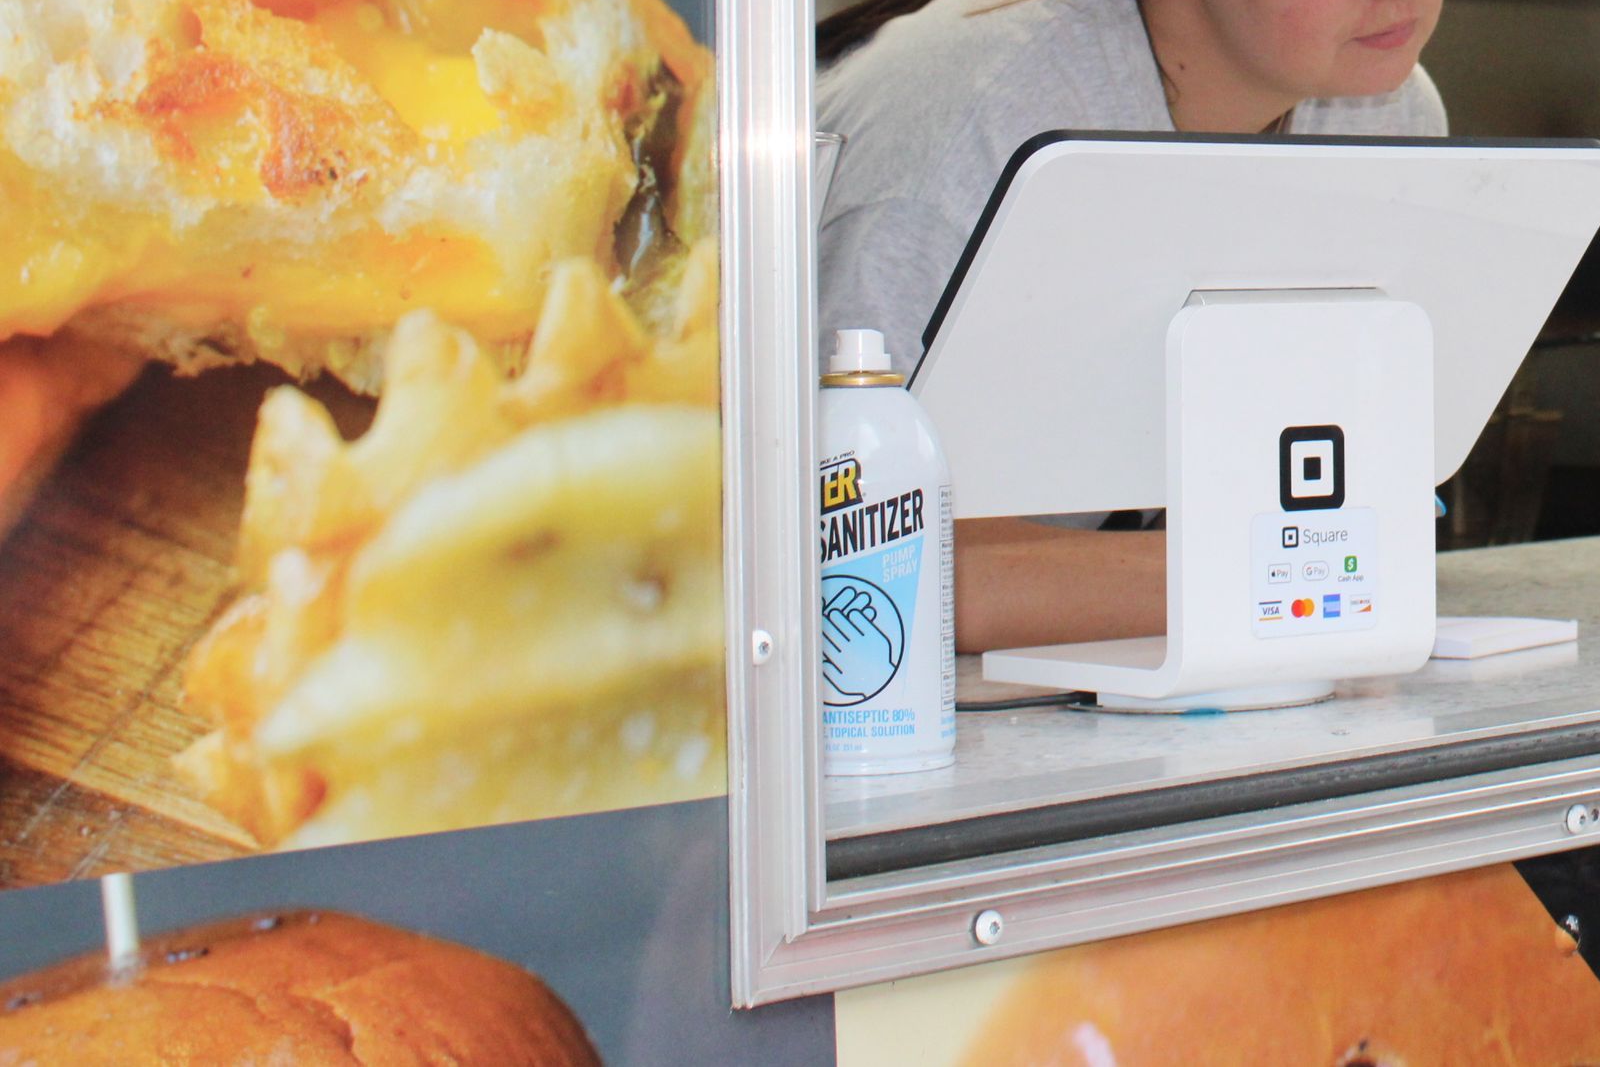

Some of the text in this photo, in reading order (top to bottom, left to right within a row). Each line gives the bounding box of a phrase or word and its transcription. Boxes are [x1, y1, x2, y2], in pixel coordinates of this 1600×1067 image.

[823, 464, 858, 508] ER
[1303, 529, 1349, 546] Square
[882, 543, 916, 568] PUMP
[883, 559, 918, 583] SPRAY
[1262, 606, 1280, 616] VISA
[823, 709, 889, 725] ANTISEPTIC
[830, 724, 916, 739] TOPICAL SOLUTION
